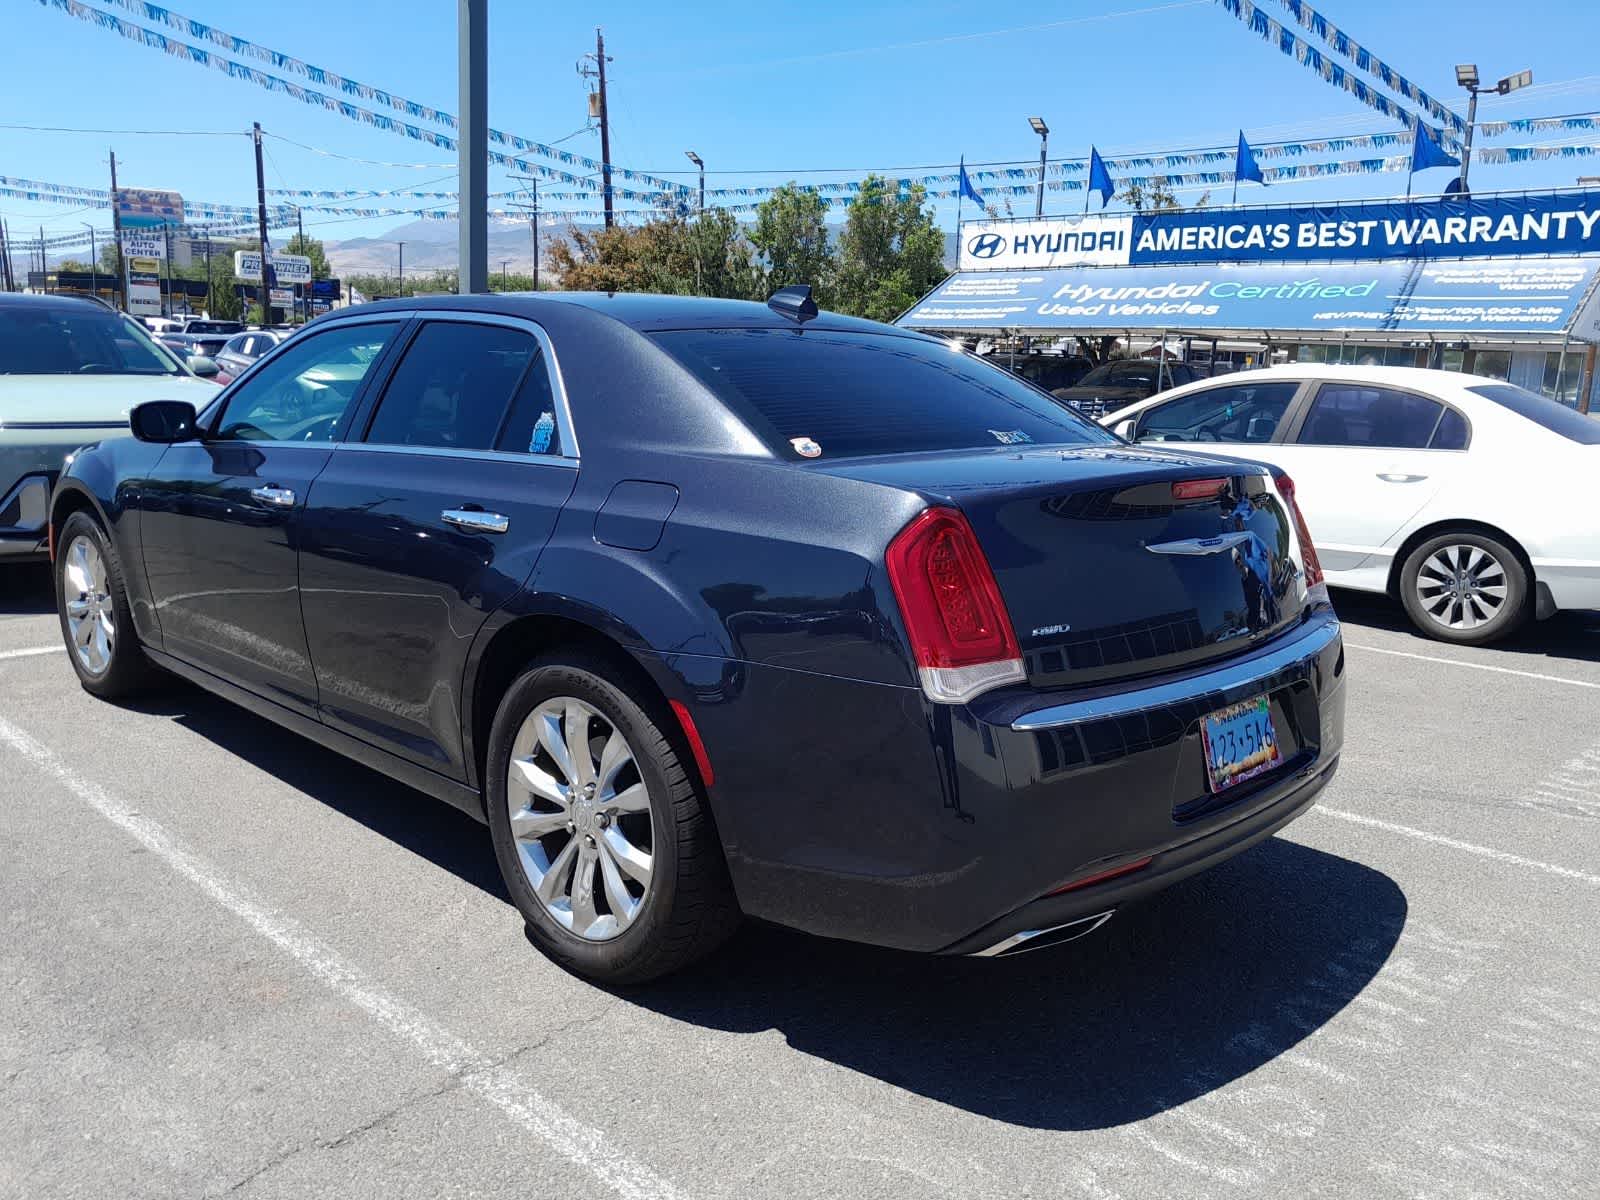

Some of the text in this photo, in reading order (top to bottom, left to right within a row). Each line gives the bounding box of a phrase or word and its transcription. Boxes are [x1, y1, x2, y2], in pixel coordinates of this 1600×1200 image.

[1136, 209, 1600, 252] AMERICA'S BEST WARRANTY
[130, 241, 156, 249] AUTO
[1013, 231, 1124, 254] HYUNDAI
[124, 247, 161, 257] CENTER
[1052, 277, 1379, 303] Hyundai Certified
[1498, 282, 1577, 291] Warranty
[1037, 302, 1105, 316] Used
[1108, 301, 1221, 316] Vehicles
[1416, 314, 1479, 323] Battery
[1479, 314, 1560, 323] Warranty
